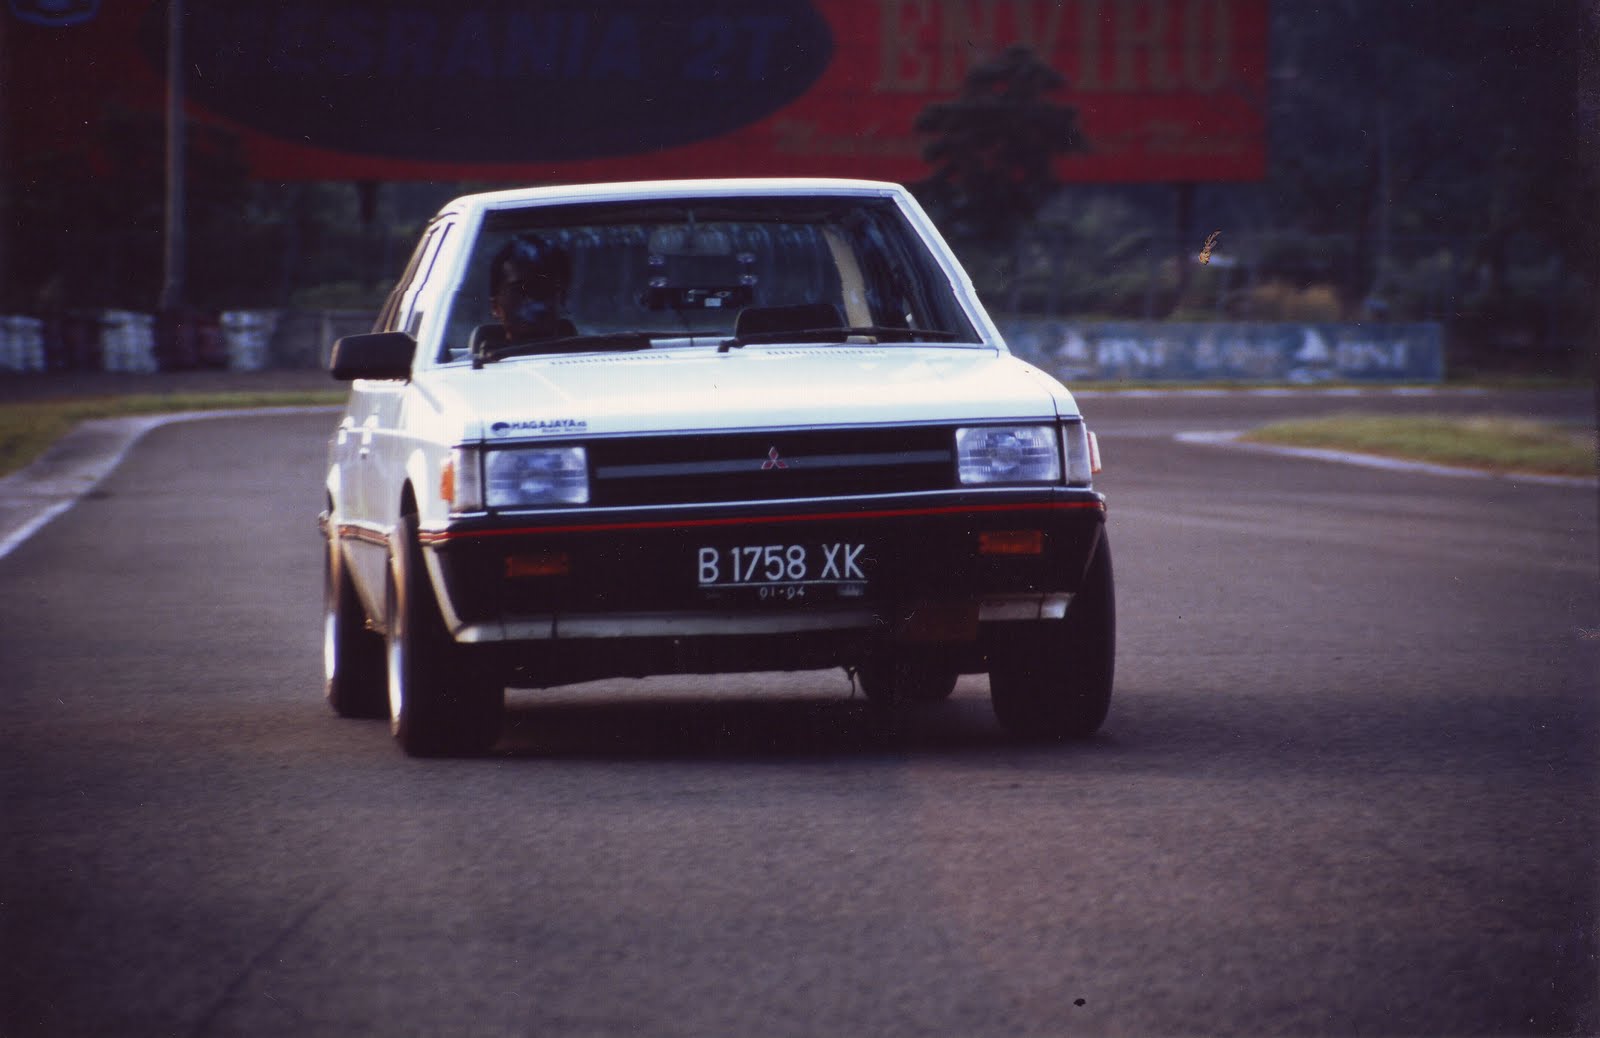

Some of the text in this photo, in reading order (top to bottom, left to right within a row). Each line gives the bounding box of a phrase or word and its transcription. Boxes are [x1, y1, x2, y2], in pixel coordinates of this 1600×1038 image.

[684, 14, 788, 81] 2T
[698, 543, 866, 584] B 1758 XK
